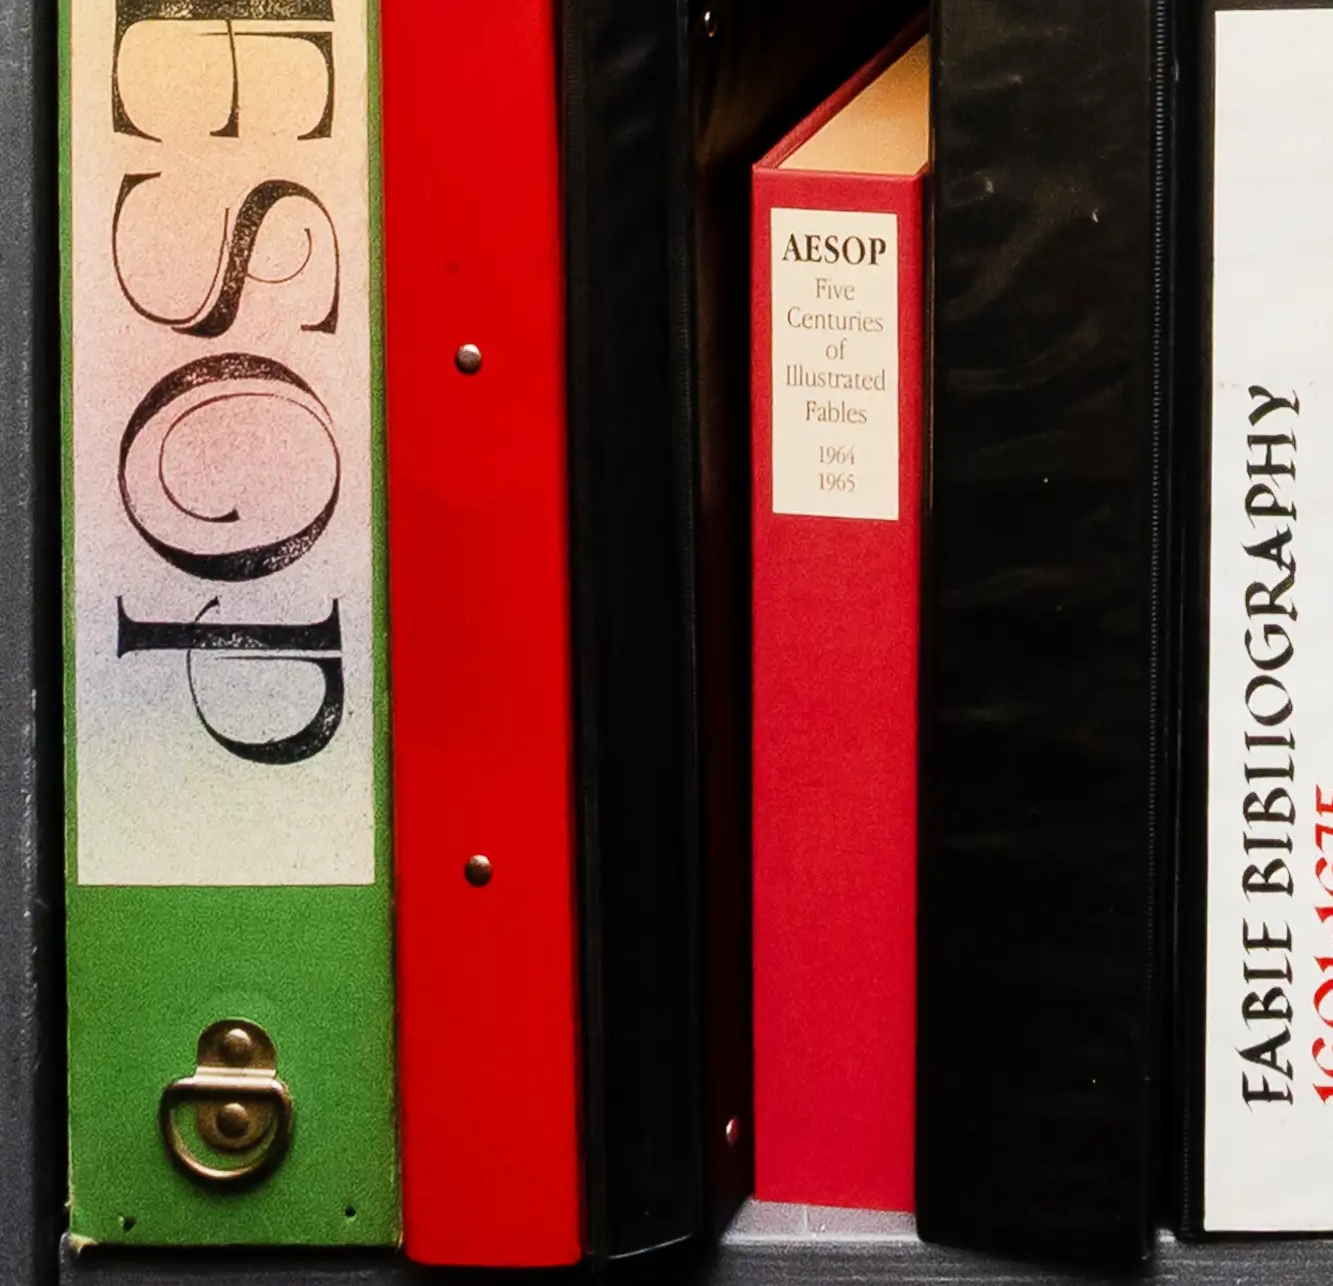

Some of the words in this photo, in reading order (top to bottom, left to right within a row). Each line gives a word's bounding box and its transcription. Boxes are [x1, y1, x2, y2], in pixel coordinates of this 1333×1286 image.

[783, 234, 886, 265] AESOP
[816, 278, 854, 300] Five
[788, 307, 883, 332] Centuries
[826, 338, 847, 359] of
[787, 365, 885, 390] Illustrated
[806, 401, 867, 423] Fables
[820, 446, 854, 465] 1964
[819, 473, 855, 491] 1965
[1242, 386, 1299, 896] BIBLIOGRAPHY
[1238, 919, 1293, 1105] FABLE
